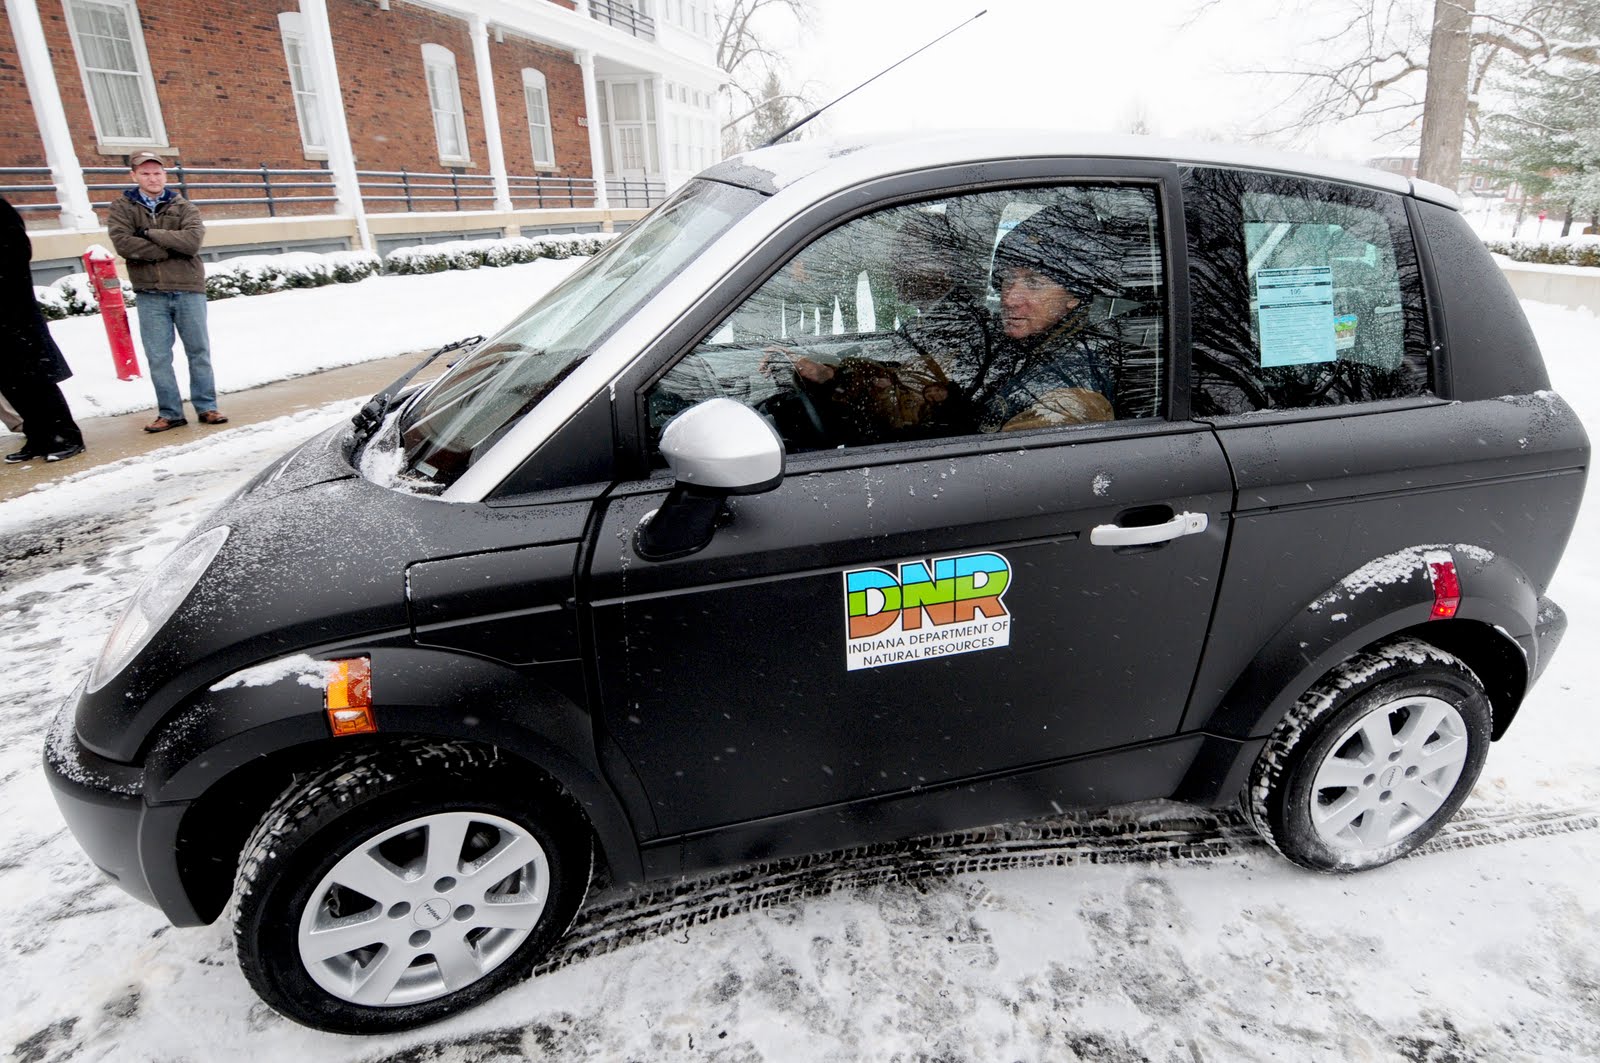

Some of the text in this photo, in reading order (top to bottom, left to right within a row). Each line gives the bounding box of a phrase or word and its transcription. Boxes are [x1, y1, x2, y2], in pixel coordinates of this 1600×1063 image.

[847, 553, 1009, 639] DNR
[848, 620, 1009, 655] INDIANA DEPARTMENT OF
[863, 636, 995, 667] NATURAL RESOURCES
